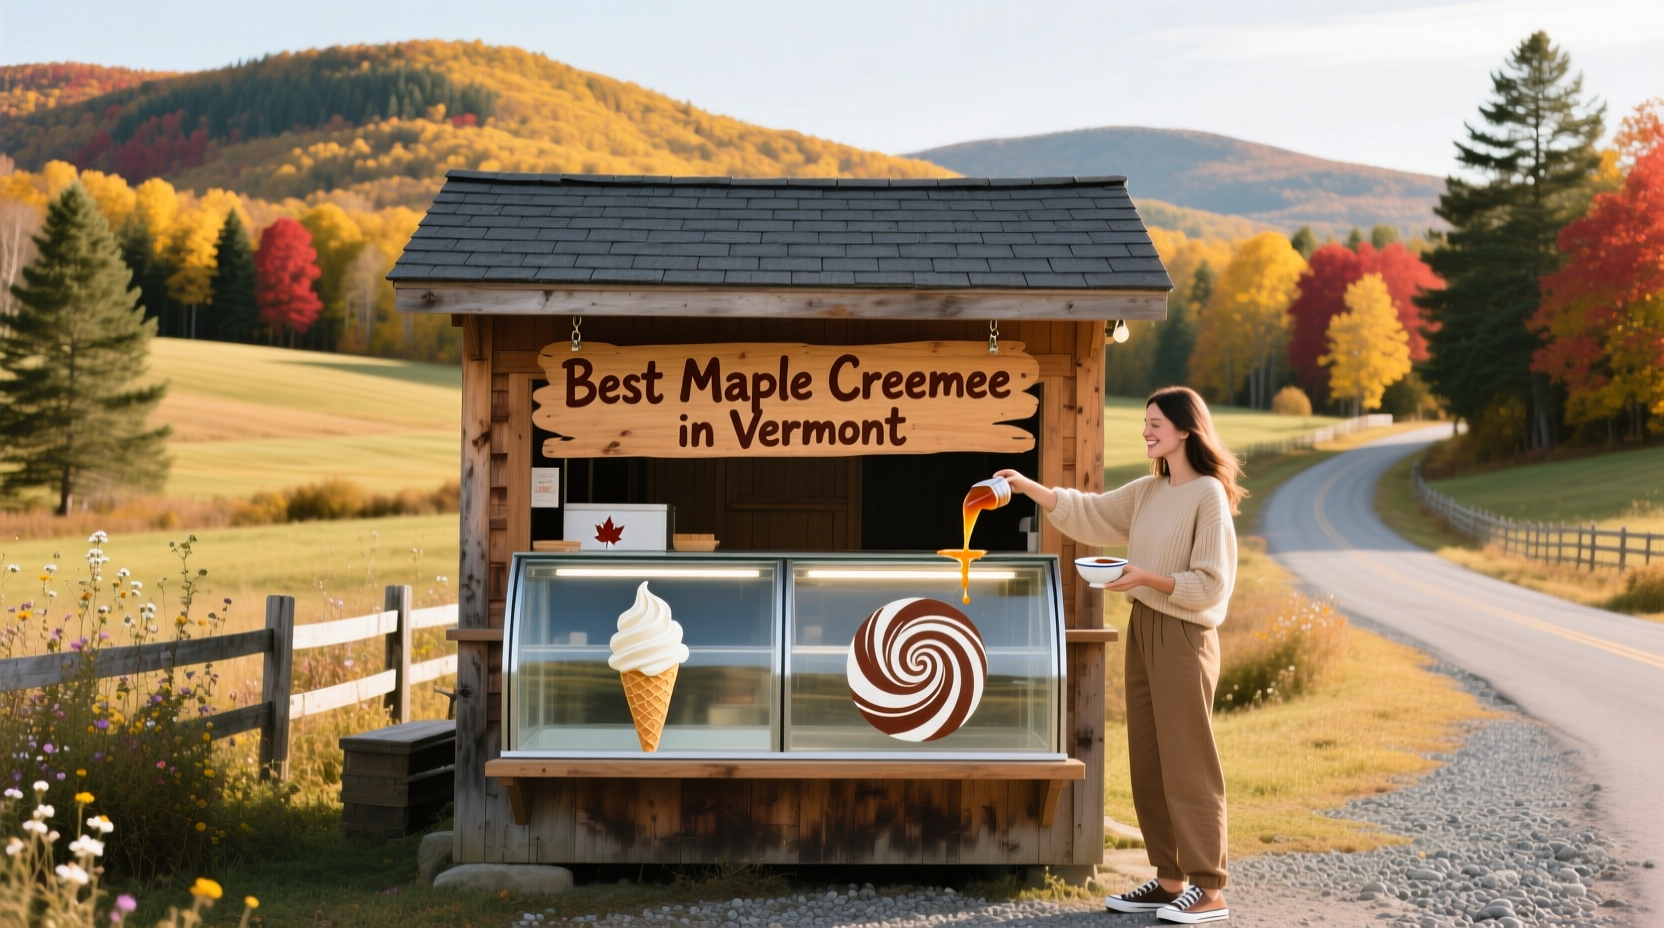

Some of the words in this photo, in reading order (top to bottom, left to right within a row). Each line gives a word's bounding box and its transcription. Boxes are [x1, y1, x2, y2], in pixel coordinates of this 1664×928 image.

[562, 357, 664, 407] Best
[679, 354, 813, 412] Maple
[828, 353, 1012, 402] Creemee
[678, 413, 715, 448] in
[729, 406, 907, 450] Vermont
